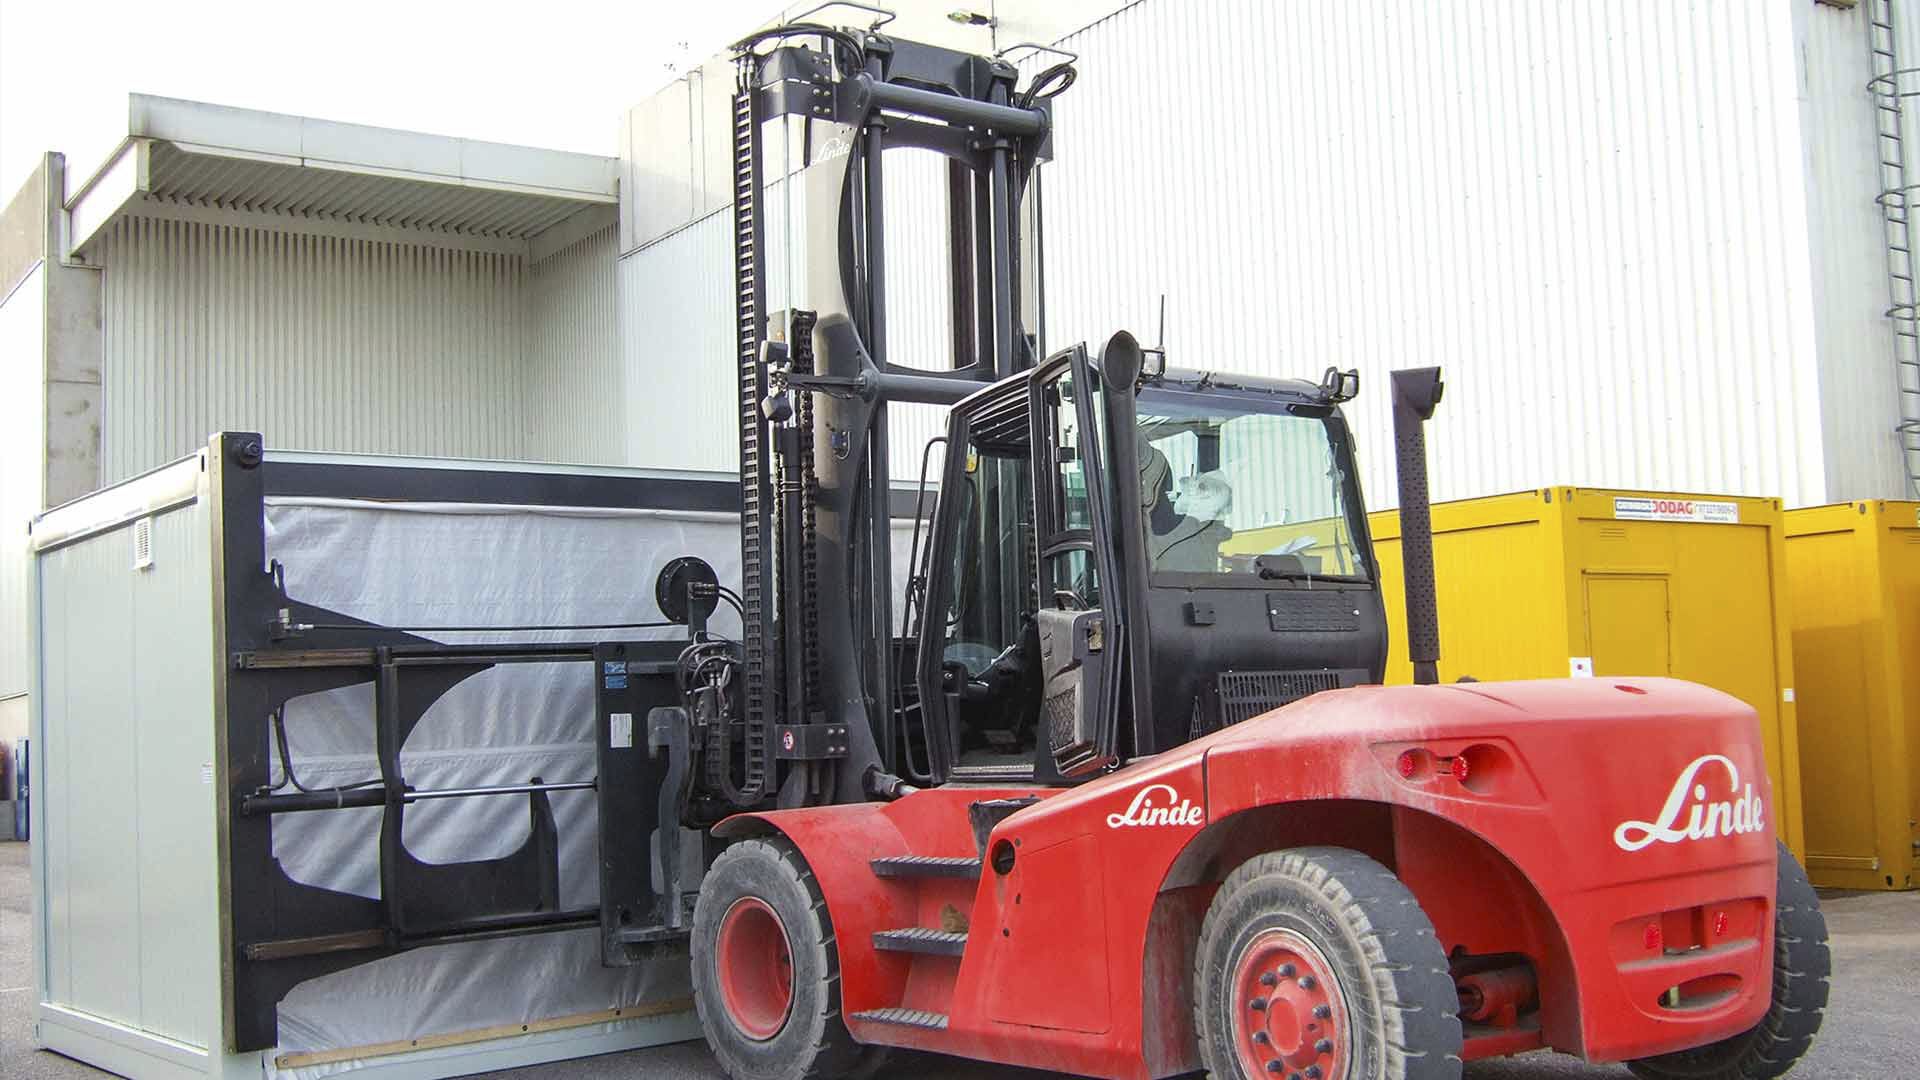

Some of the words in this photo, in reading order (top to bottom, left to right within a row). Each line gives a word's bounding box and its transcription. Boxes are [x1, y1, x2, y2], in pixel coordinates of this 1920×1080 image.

[811, 137, 850, 166] Linde
[1106, 784, 1203, 829] Linde
[1613, 754, 1765, 851] Linde
